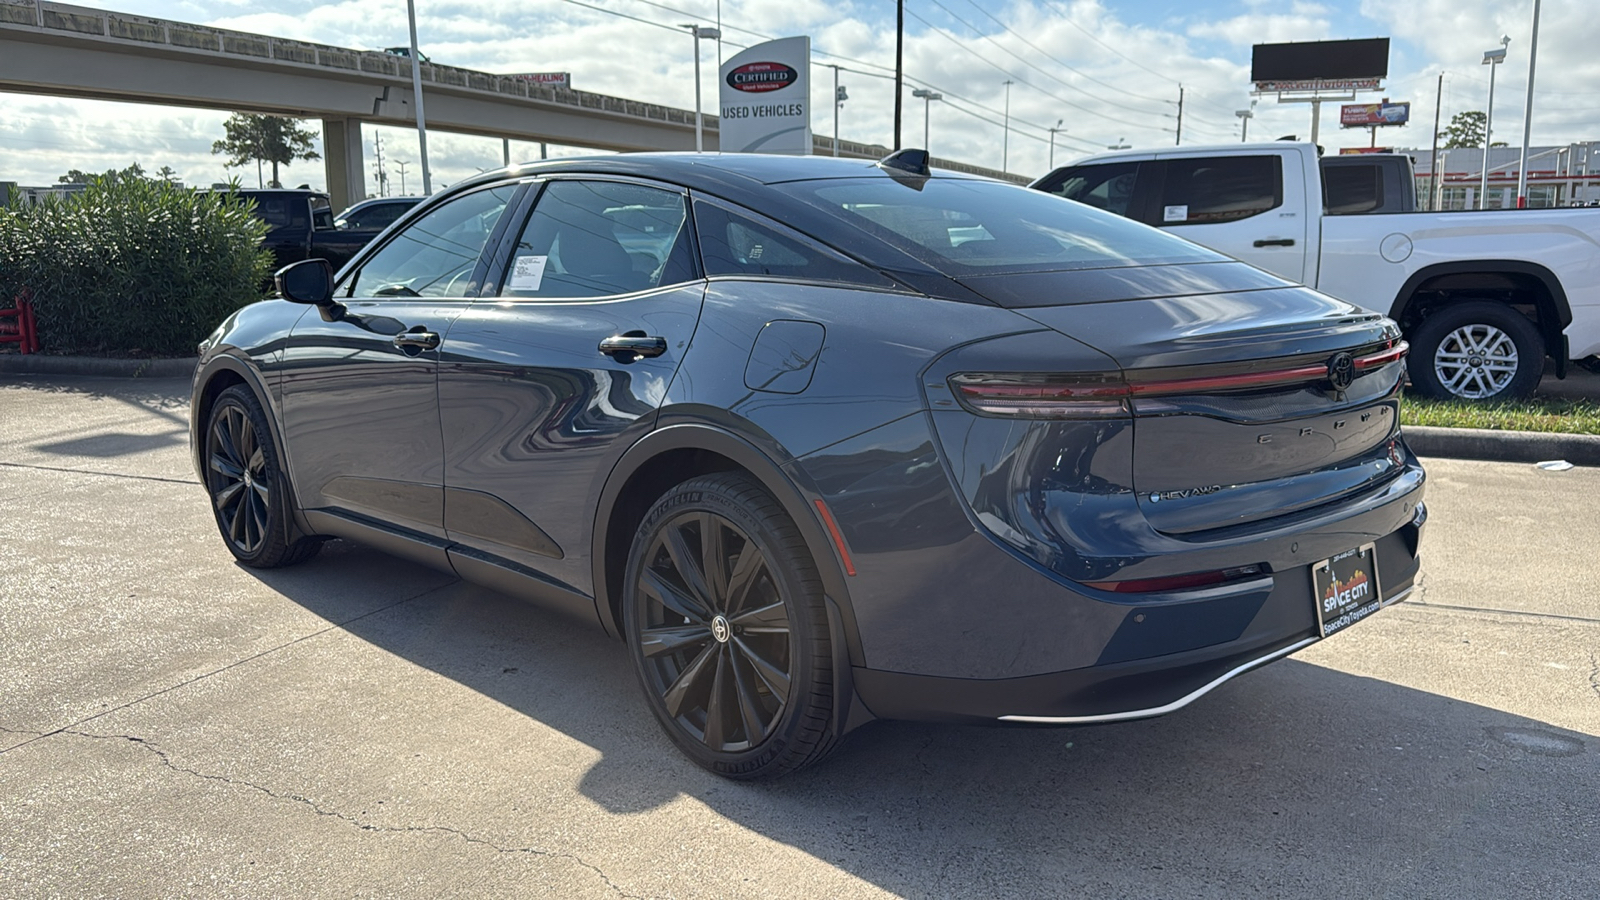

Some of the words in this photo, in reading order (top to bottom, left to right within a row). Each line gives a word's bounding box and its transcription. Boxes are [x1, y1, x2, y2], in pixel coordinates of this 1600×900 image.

[734, 71, 788, 83] CERTIFIED
[722, 106, 749, 119] USED
[752, 104, 803, 118] VEHICLES
[1257, 406, 1389, 444] CROWN
[650, 491, 702, 520] MICHELIN
[1160, 490, 1190, 501] HEV
[1191, 484, 1221, 497] AWD
[1323, 589, 1351, 613] SPACE
[1351, 580, 1369, 600] CITY
[1324, 601, 1380, 634] SpaceCityToyota.com
